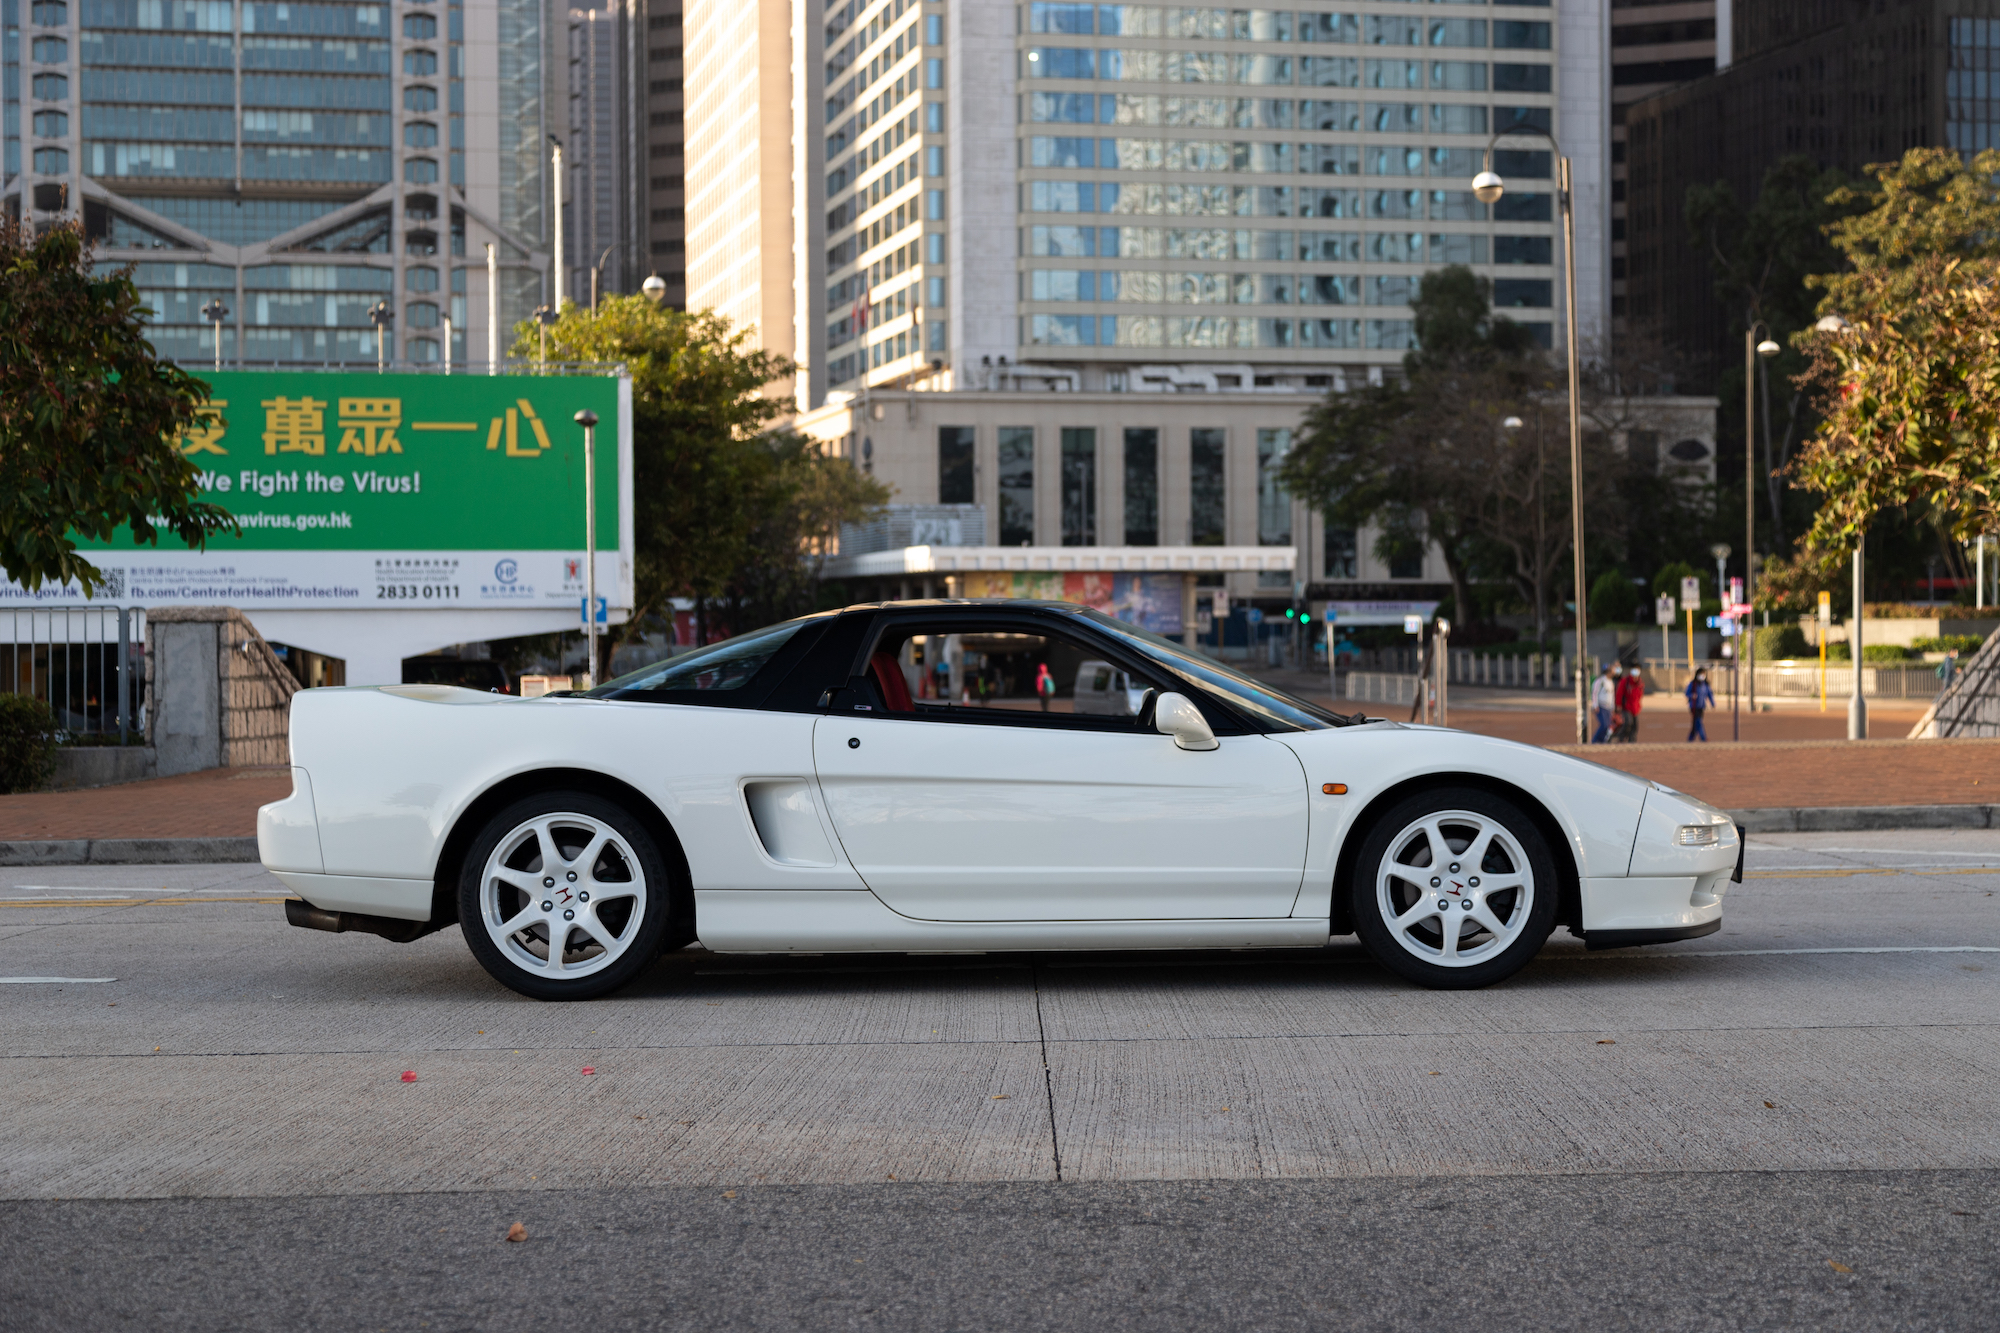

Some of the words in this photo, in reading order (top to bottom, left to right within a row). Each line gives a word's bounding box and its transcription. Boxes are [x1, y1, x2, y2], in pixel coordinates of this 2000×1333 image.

[261, 396, 552, 457] 萬眾一心
[192, 470, 232, 493] We
[239, 470, 299, 497] Fight
[305, 470, 345, 493] the
[352, 470, 421, 494] Virus!
[376, 584, 418, 599] 2833
[422, 584, 460, 599] 0111
[622, 821, 663, 901] POTENZA
